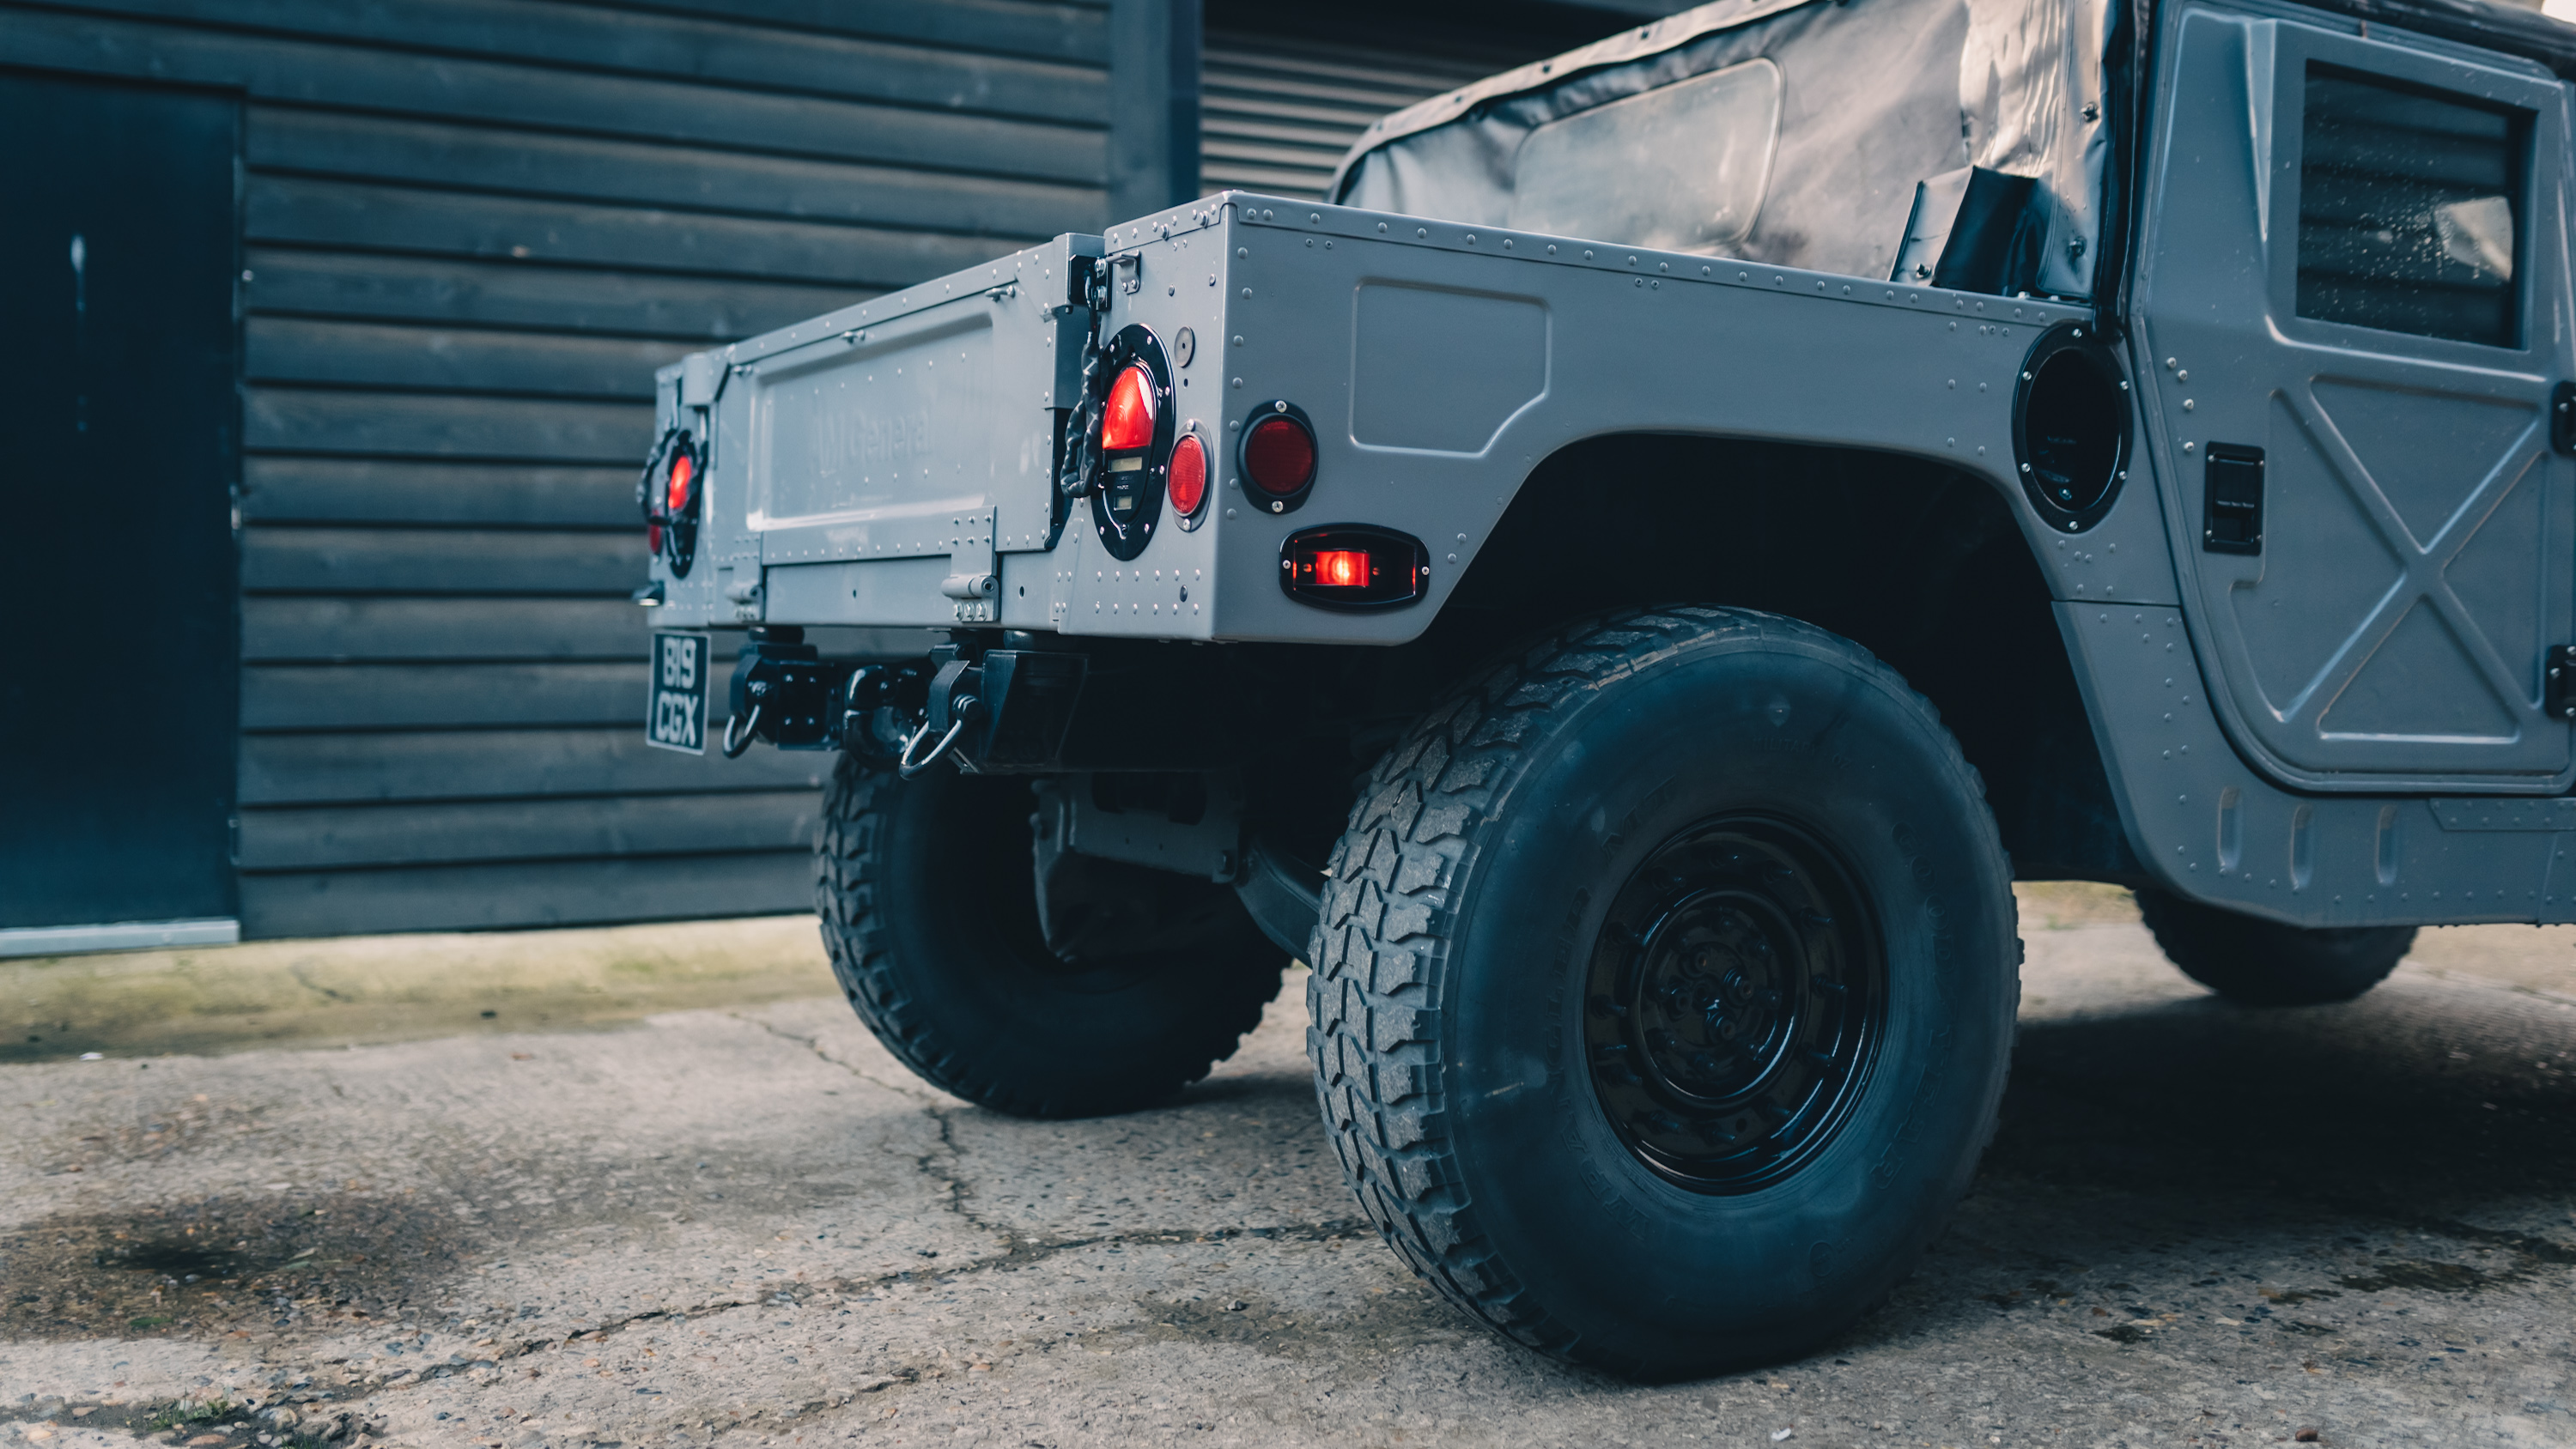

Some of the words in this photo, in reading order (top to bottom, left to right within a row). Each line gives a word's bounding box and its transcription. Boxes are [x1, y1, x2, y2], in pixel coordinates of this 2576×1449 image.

[656, 690, 699, 747] CGX
[663, 637, 696, 689] B19
[1545, 885, 1651, 1242] WRANGLER
[1869, 820, 1959, 1190] GOODYEAR
